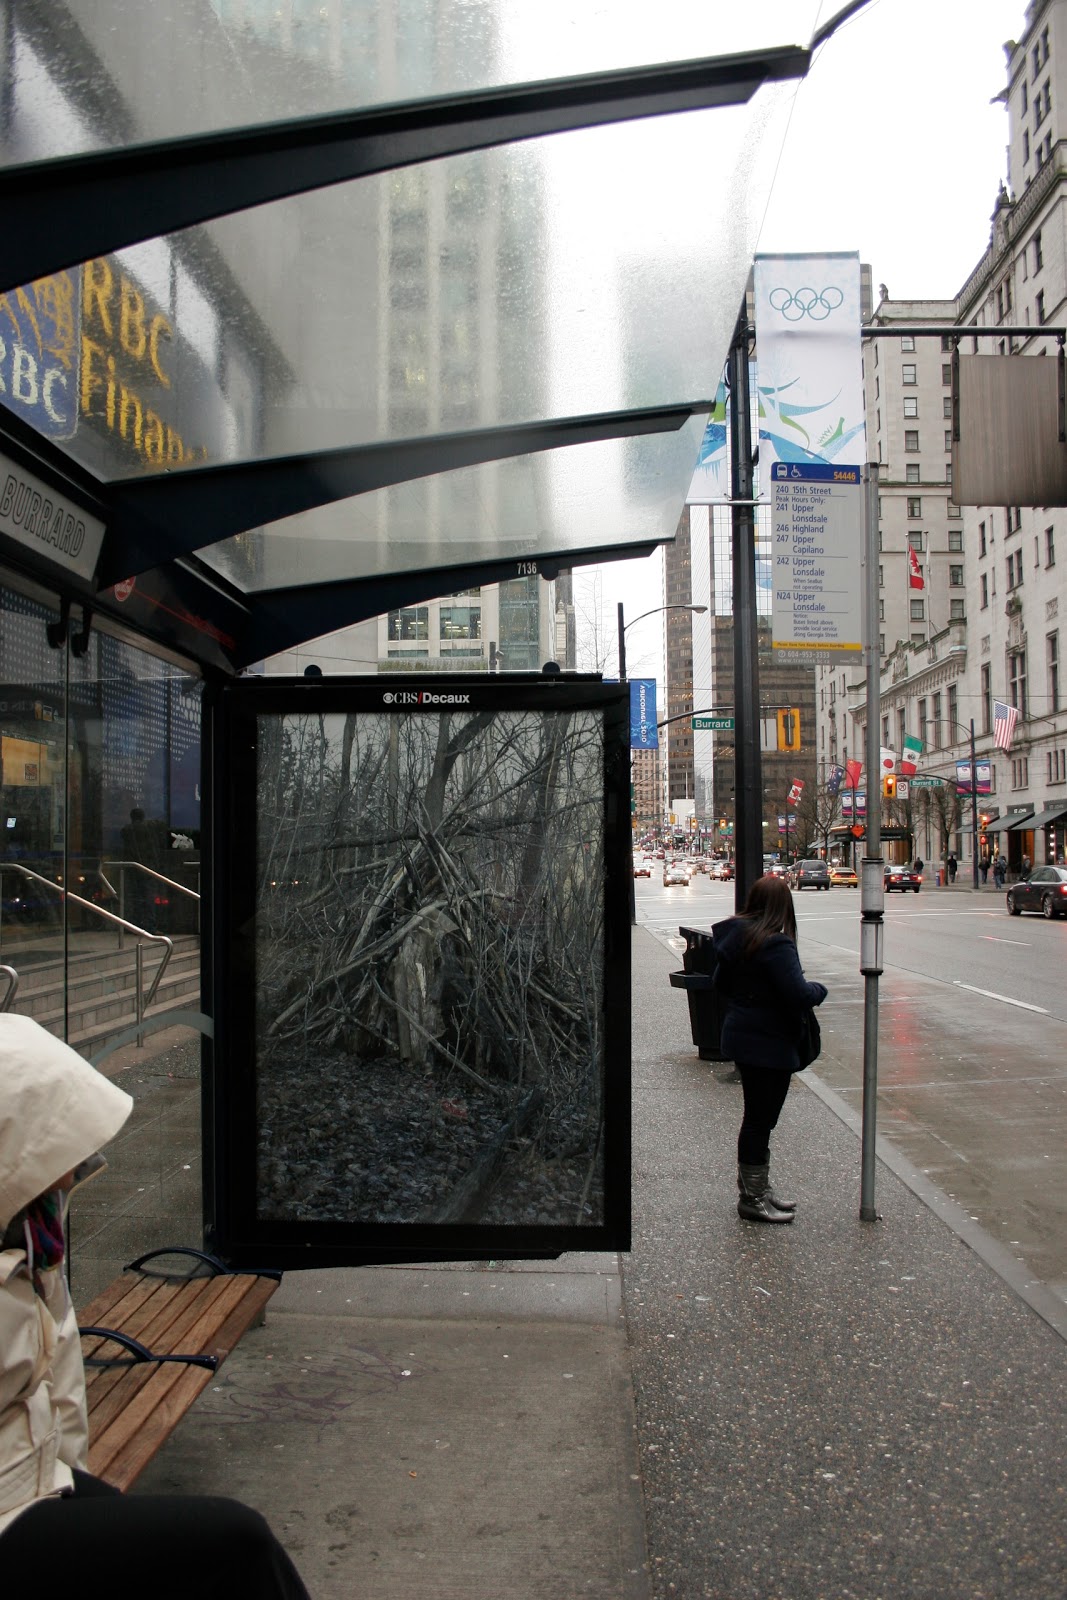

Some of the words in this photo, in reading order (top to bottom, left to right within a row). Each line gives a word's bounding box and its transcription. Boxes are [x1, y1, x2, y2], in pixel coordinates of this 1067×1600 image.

[83, 257, 172, 388] RBC
[833, 471, 856, 480] 54446
[776, 485, 789, 494] 240
[792, 485, 807, 494] 15th
[809, 486, 832, 495] Street
[810, 496, 826, 505] Only:
[776, 503, 788, 511] 241
[792, 504, 814, 513] Upper
[0, 474, 86, 558] BURRARD
[792, 514, 828, 523] Lonsdsale
[776, 524, 789, 532] 246
[792, 524, 825, 534] Highland
[776, 534, 789, 542] 247
[792, 535, 815, 544] Upper
[792, 545, 825, 555] Capilano
[776, 557, 789, 565] 242
[792, 557, 815, 567] Upper
[517, 562, 537, 575] 7136
[792, 568, 825, 576] Lonsdale
[776, 592, 791, 600] N24
[793, 592, 815, 602] Upper
[793, 603, 825, 611] Lonsdale
[695, 719, 731, 728] Burrard
